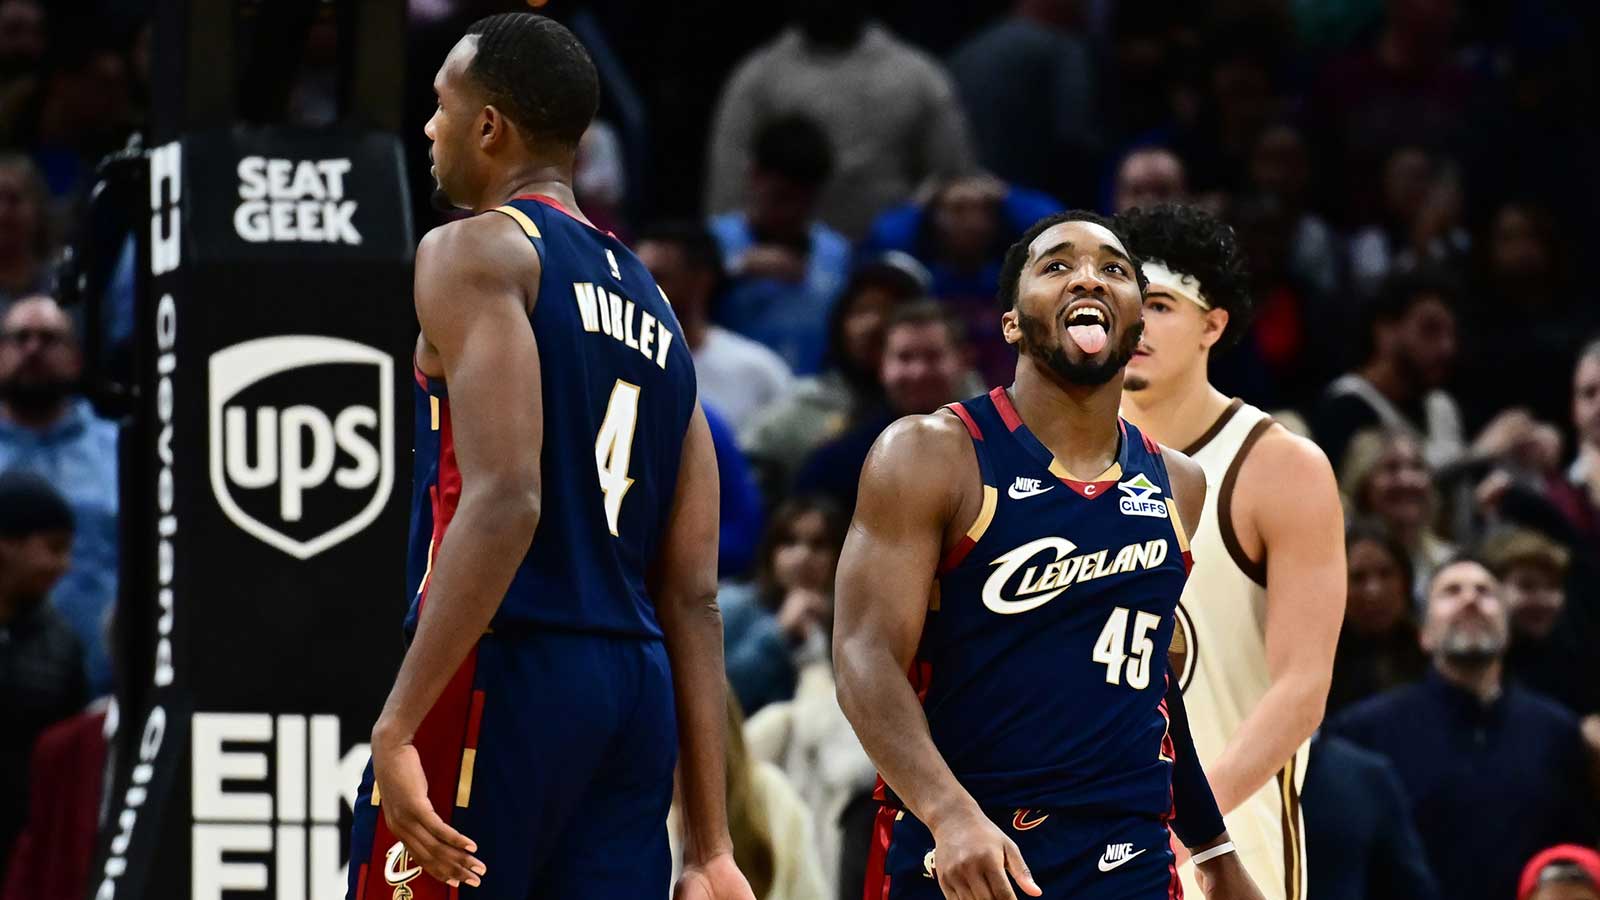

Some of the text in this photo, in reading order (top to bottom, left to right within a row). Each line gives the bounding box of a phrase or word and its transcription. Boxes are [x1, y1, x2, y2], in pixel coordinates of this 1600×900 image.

[236, 155, 352, 201] SEAT
[233, 200, 363, 245] GEEK
[573, 283, 673, 370] MOBLEY
[225, 404, 380, 522] ups
[595, 378, 641, 537] 4
[1014, 476, 1042, 492] NIKE
[1121, 500, 1166, 514] CLIFFS
[1092, 606, 1162, 690] 45
[1105, 843, 1133, 860] NIKE
